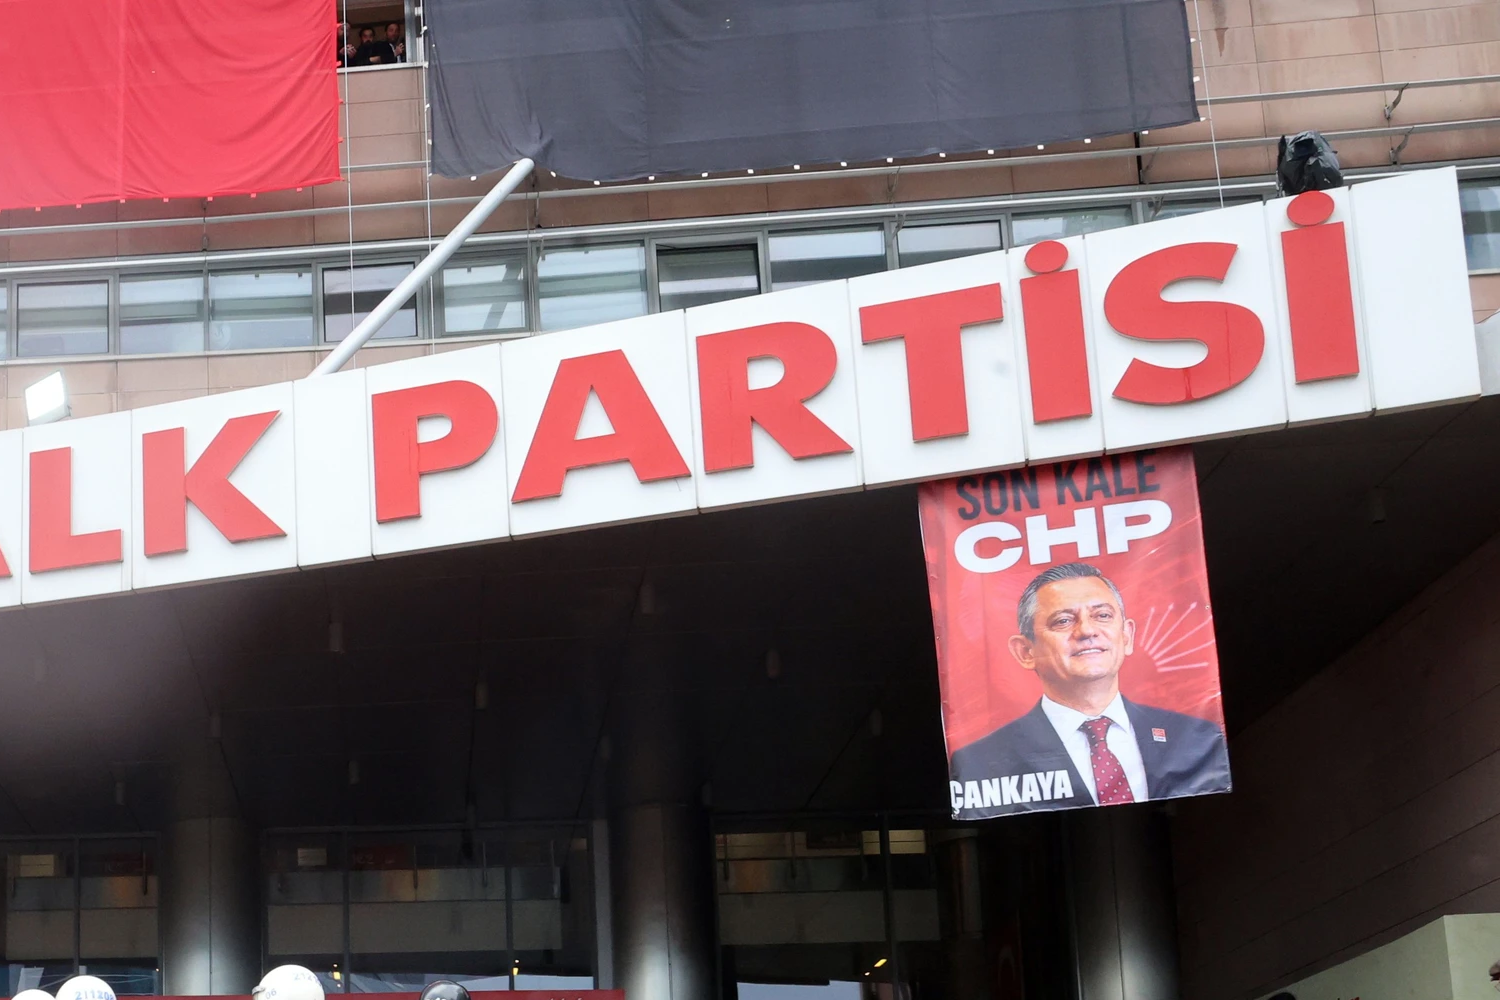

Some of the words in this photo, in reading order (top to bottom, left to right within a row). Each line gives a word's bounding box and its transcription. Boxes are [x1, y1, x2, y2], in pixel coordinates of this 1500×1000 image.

[372, 190, 1360, 523] PARTİSİ
[956, 466, 1040, 520] SON
[1053, 448, 1161, 505] KALE
[954, 500, 1173, 574] CHP
[949, 770, 1074, 814] ÇANKAYA
